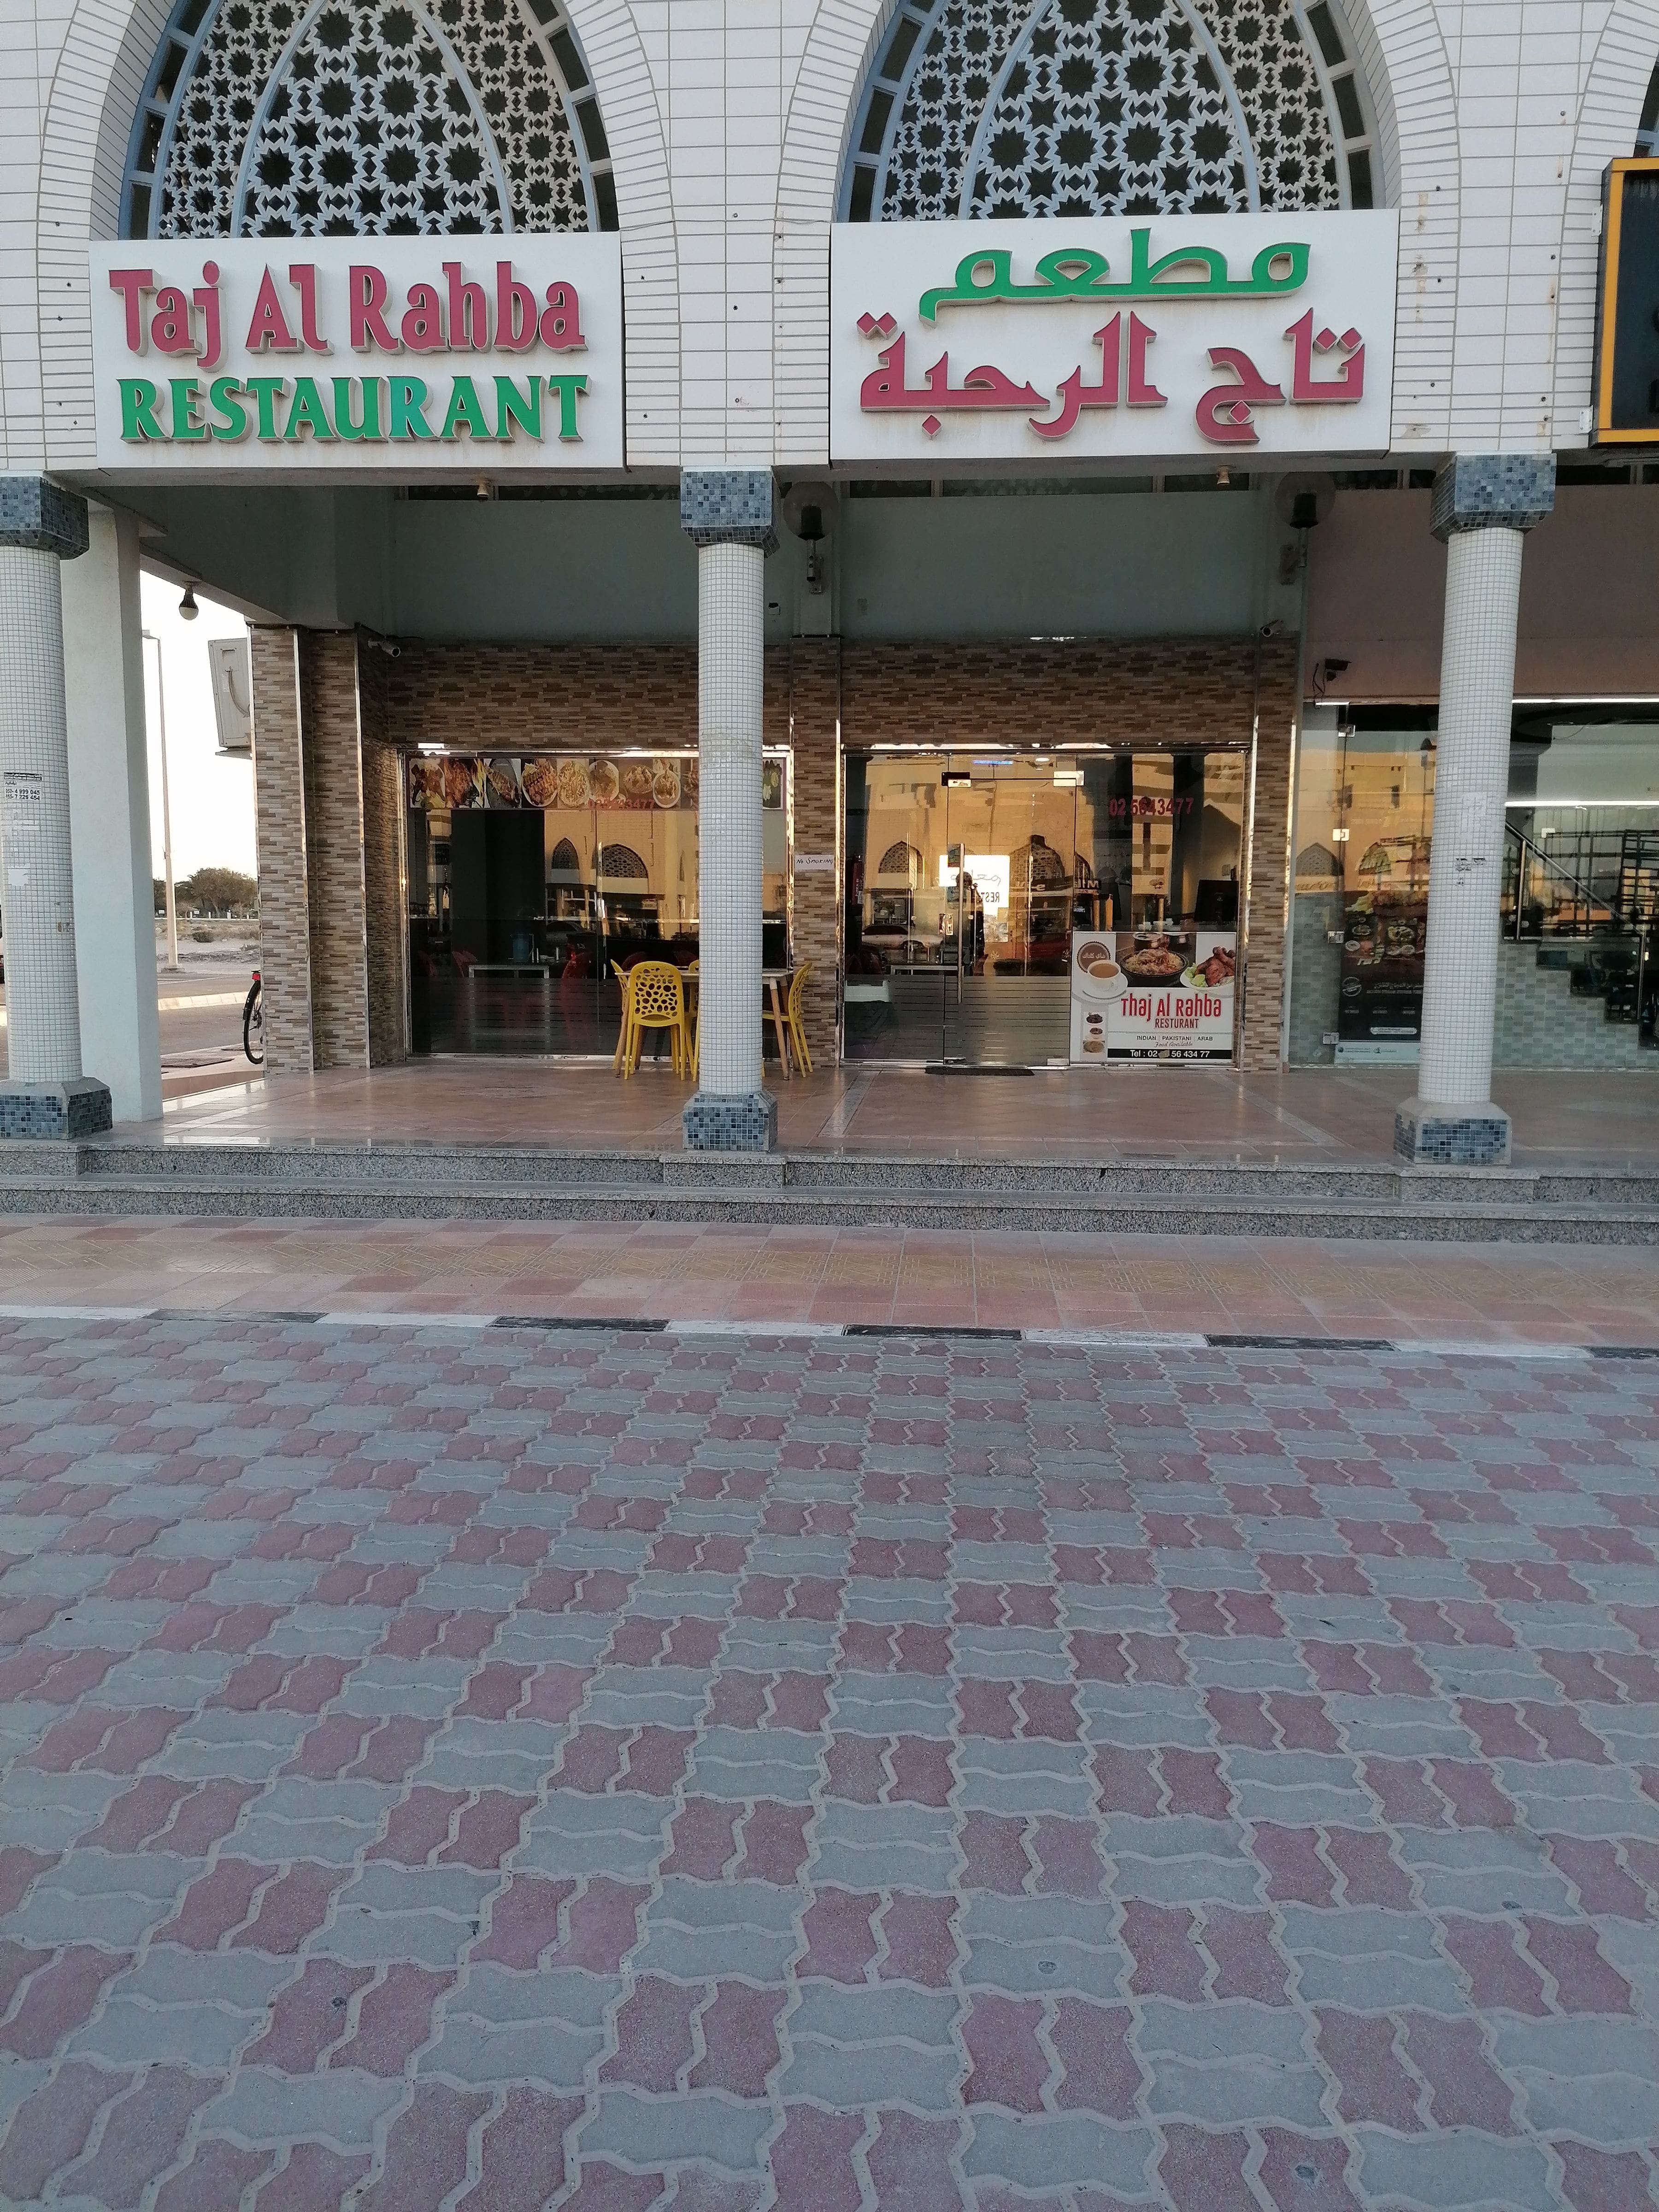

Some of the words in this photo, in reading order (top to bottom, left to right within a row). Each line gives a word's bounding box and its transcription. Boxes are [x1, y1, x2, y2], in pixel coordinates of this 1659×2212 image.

[108, 260, 227, 372] Taj
[245, 263, 334, 355] Al
[349, 261, 588, 355] Rahba
[919, 227, 1312, 328] مطعم
[116, 375, 592, 443] RESTAURANT
[857, 311, 1168, 441] الرحبة
[1196, 307, 1365, 445] تاج
[1121, 993, 1152, 1022] Thaj
[1156, 993, 1170, 1017] Al
[1176, 993, 1222, 1017] Rahba
[1154, 1018, 1199, 1029] RESTURANT
